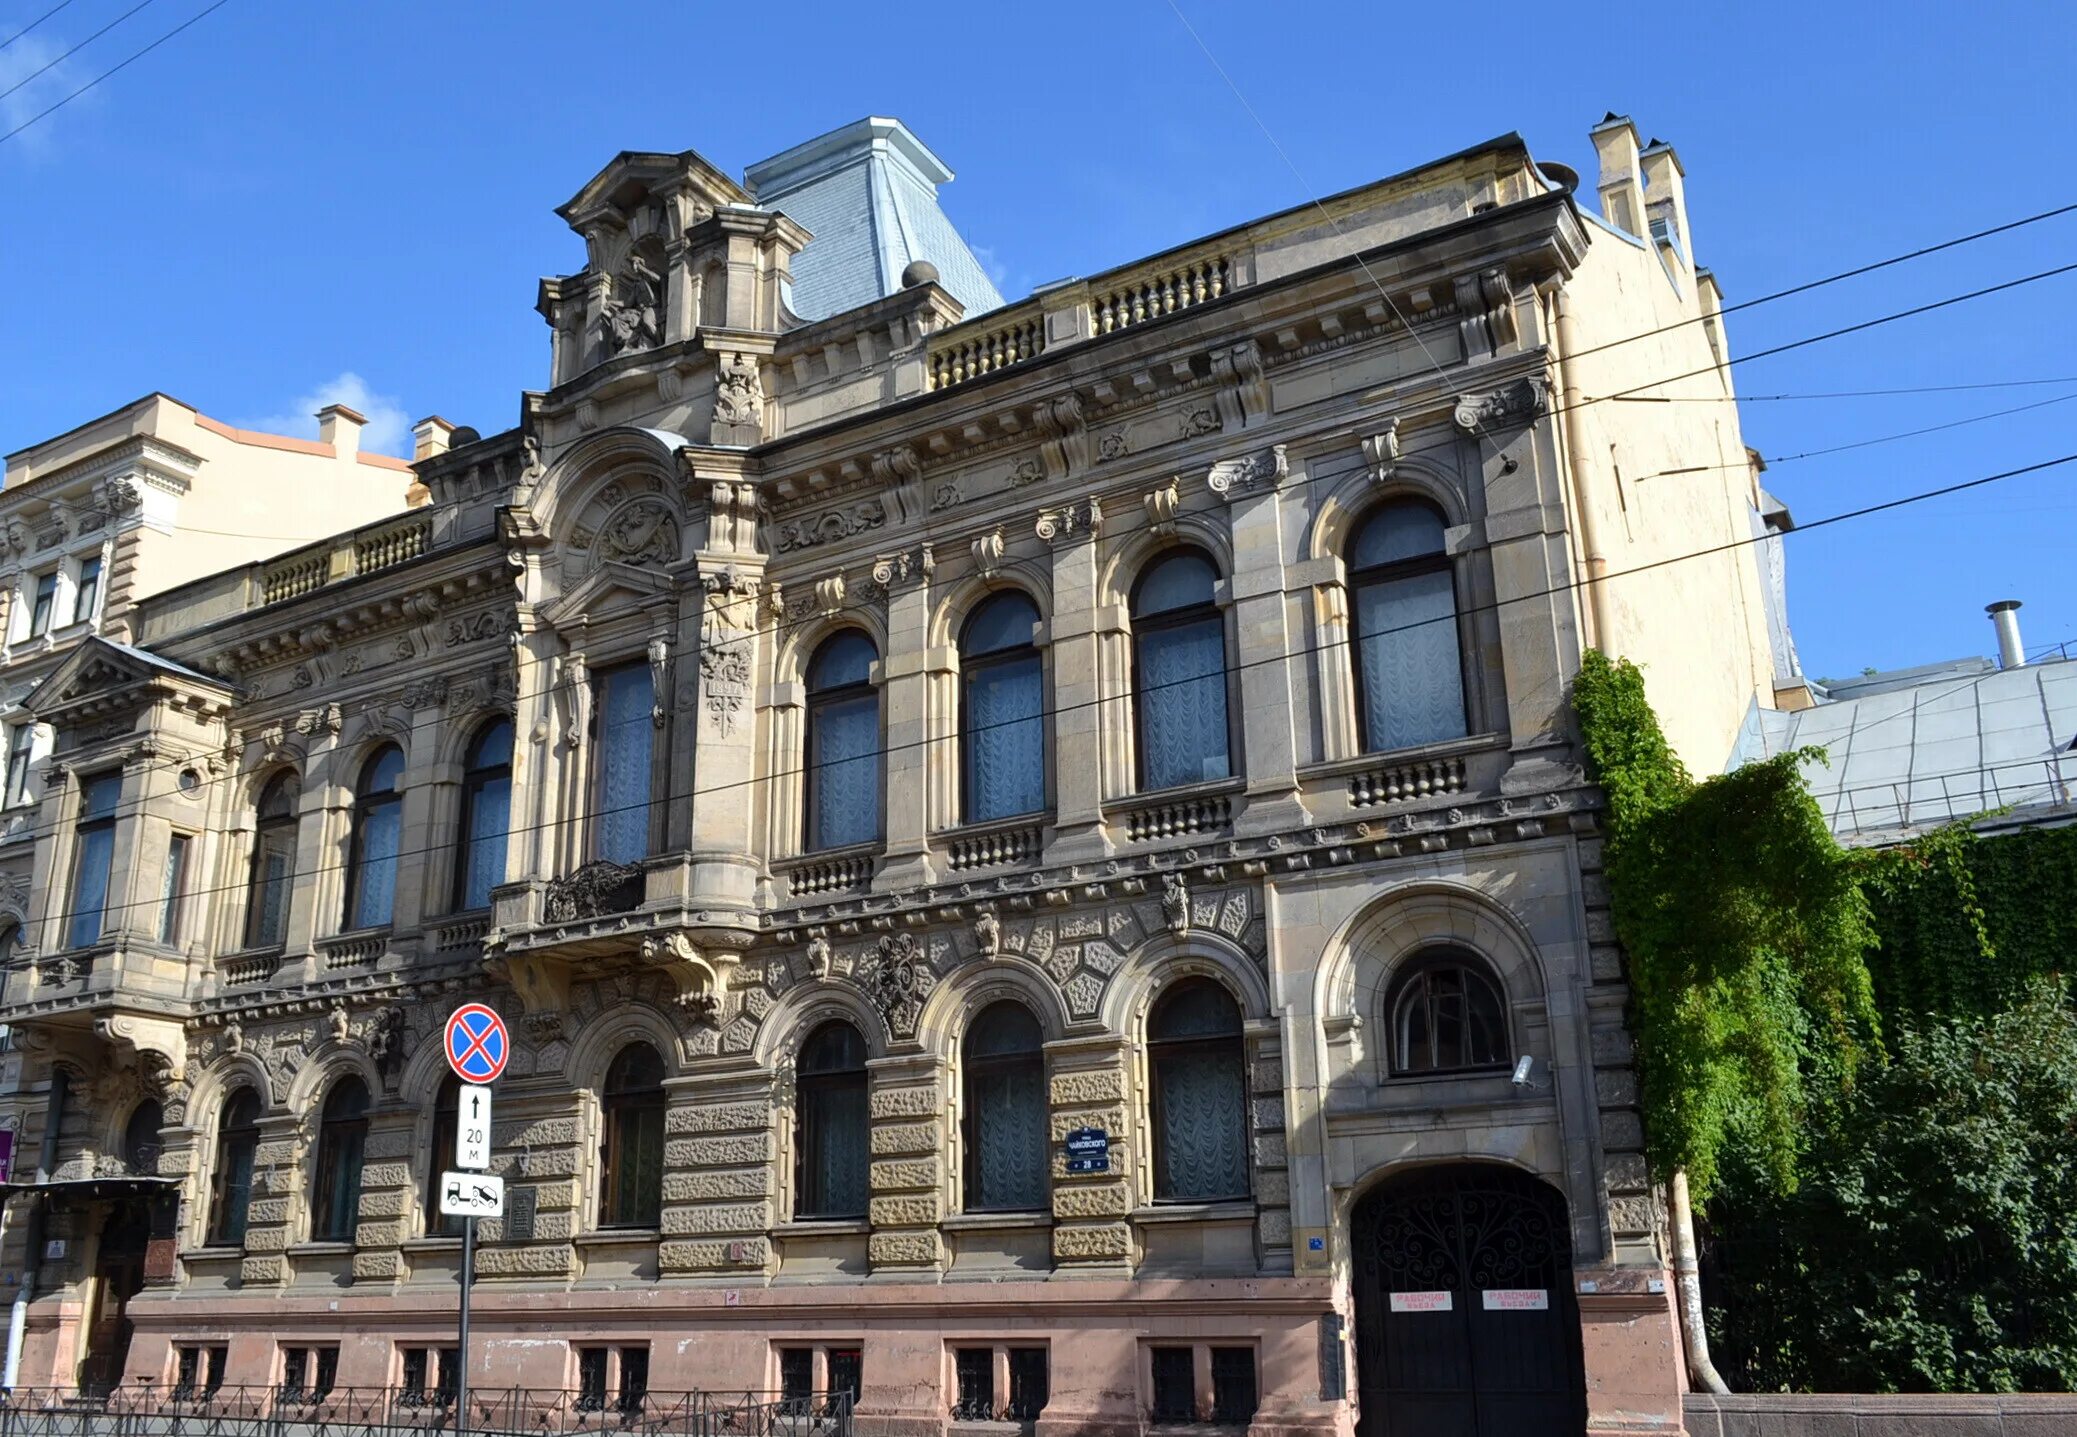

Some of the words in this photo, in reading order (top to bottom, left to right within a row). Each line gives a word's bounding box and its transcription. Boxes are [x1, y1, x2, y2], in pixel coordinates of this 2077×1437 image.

[711, 681, 742, 695] 1897
[467, 1128, 483, 1144] 20
[1083, 1160, 1092, 1169] 28
